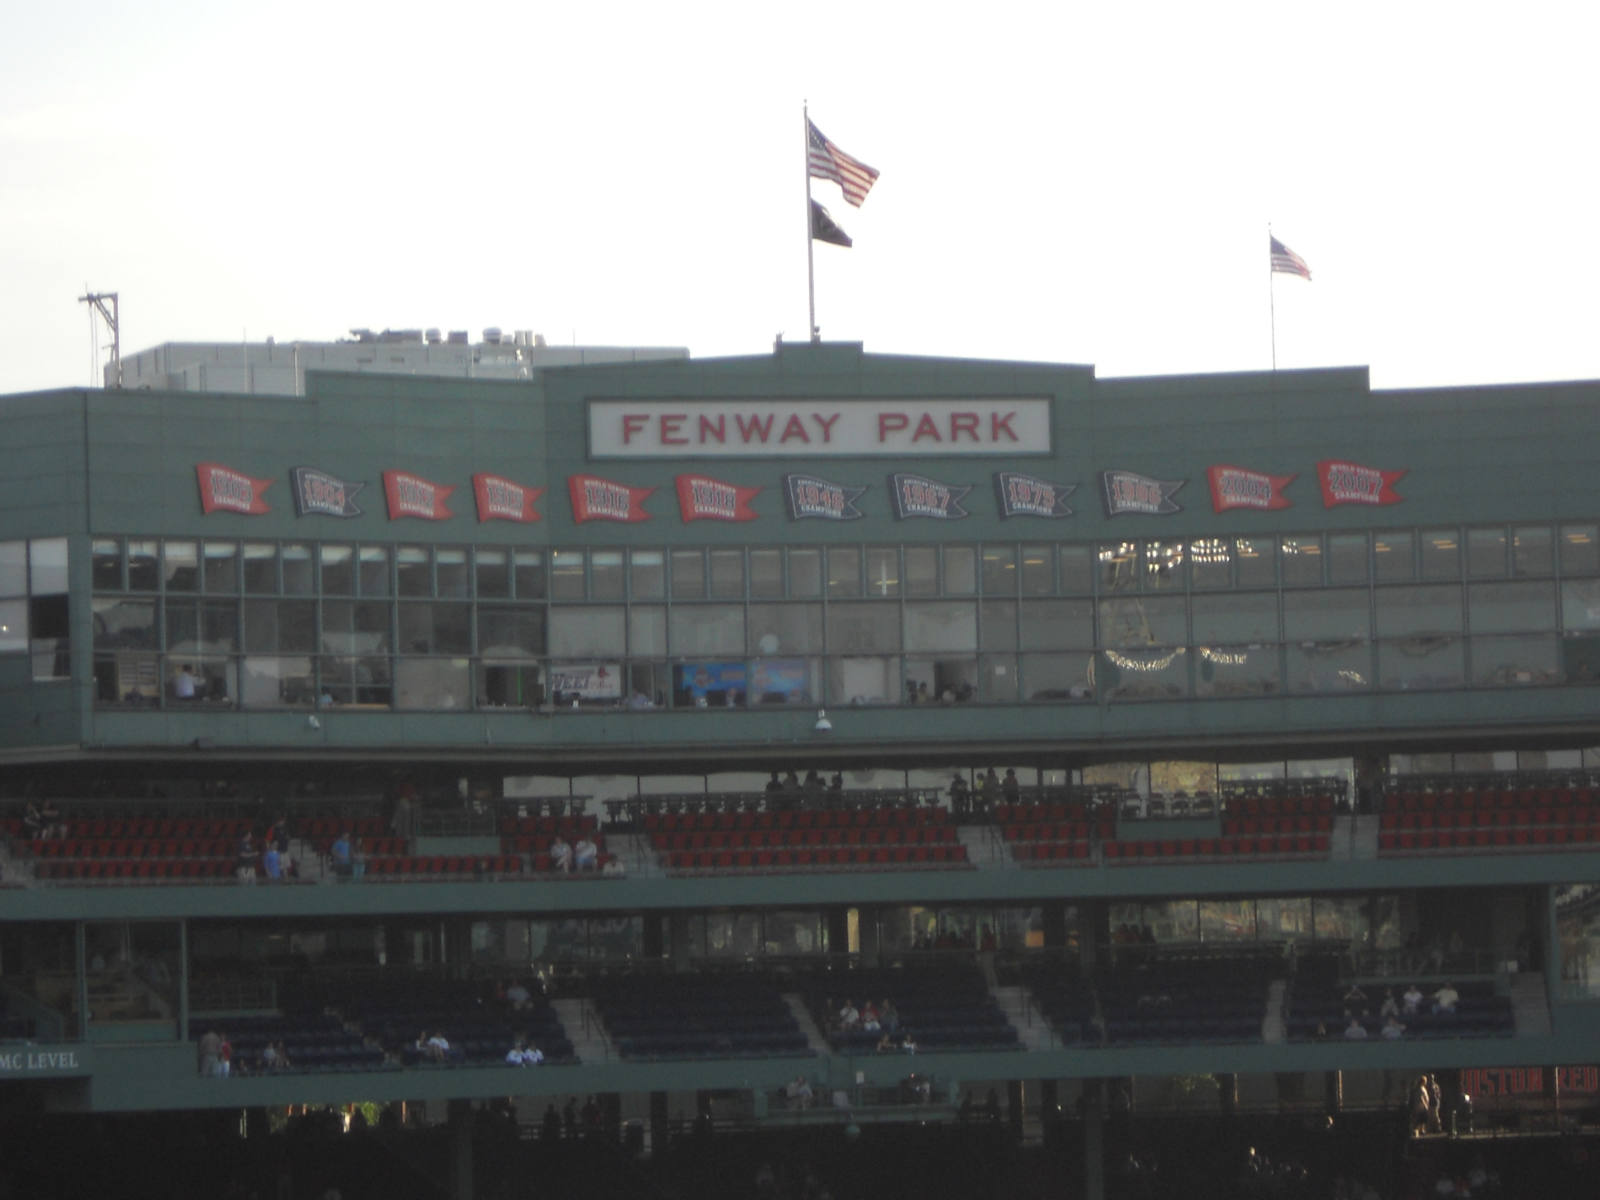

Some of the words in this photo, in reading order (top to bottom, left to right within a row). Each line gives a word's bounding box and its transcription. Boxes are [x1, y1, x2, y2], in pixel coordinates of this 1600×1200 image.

[621, 412, 841, 446] FENWAY
[878, 411, 1019, 443] PARK
[1328, 470, 1383, 497] 2007
[28, 1051, 79, 1069] LEVEL
